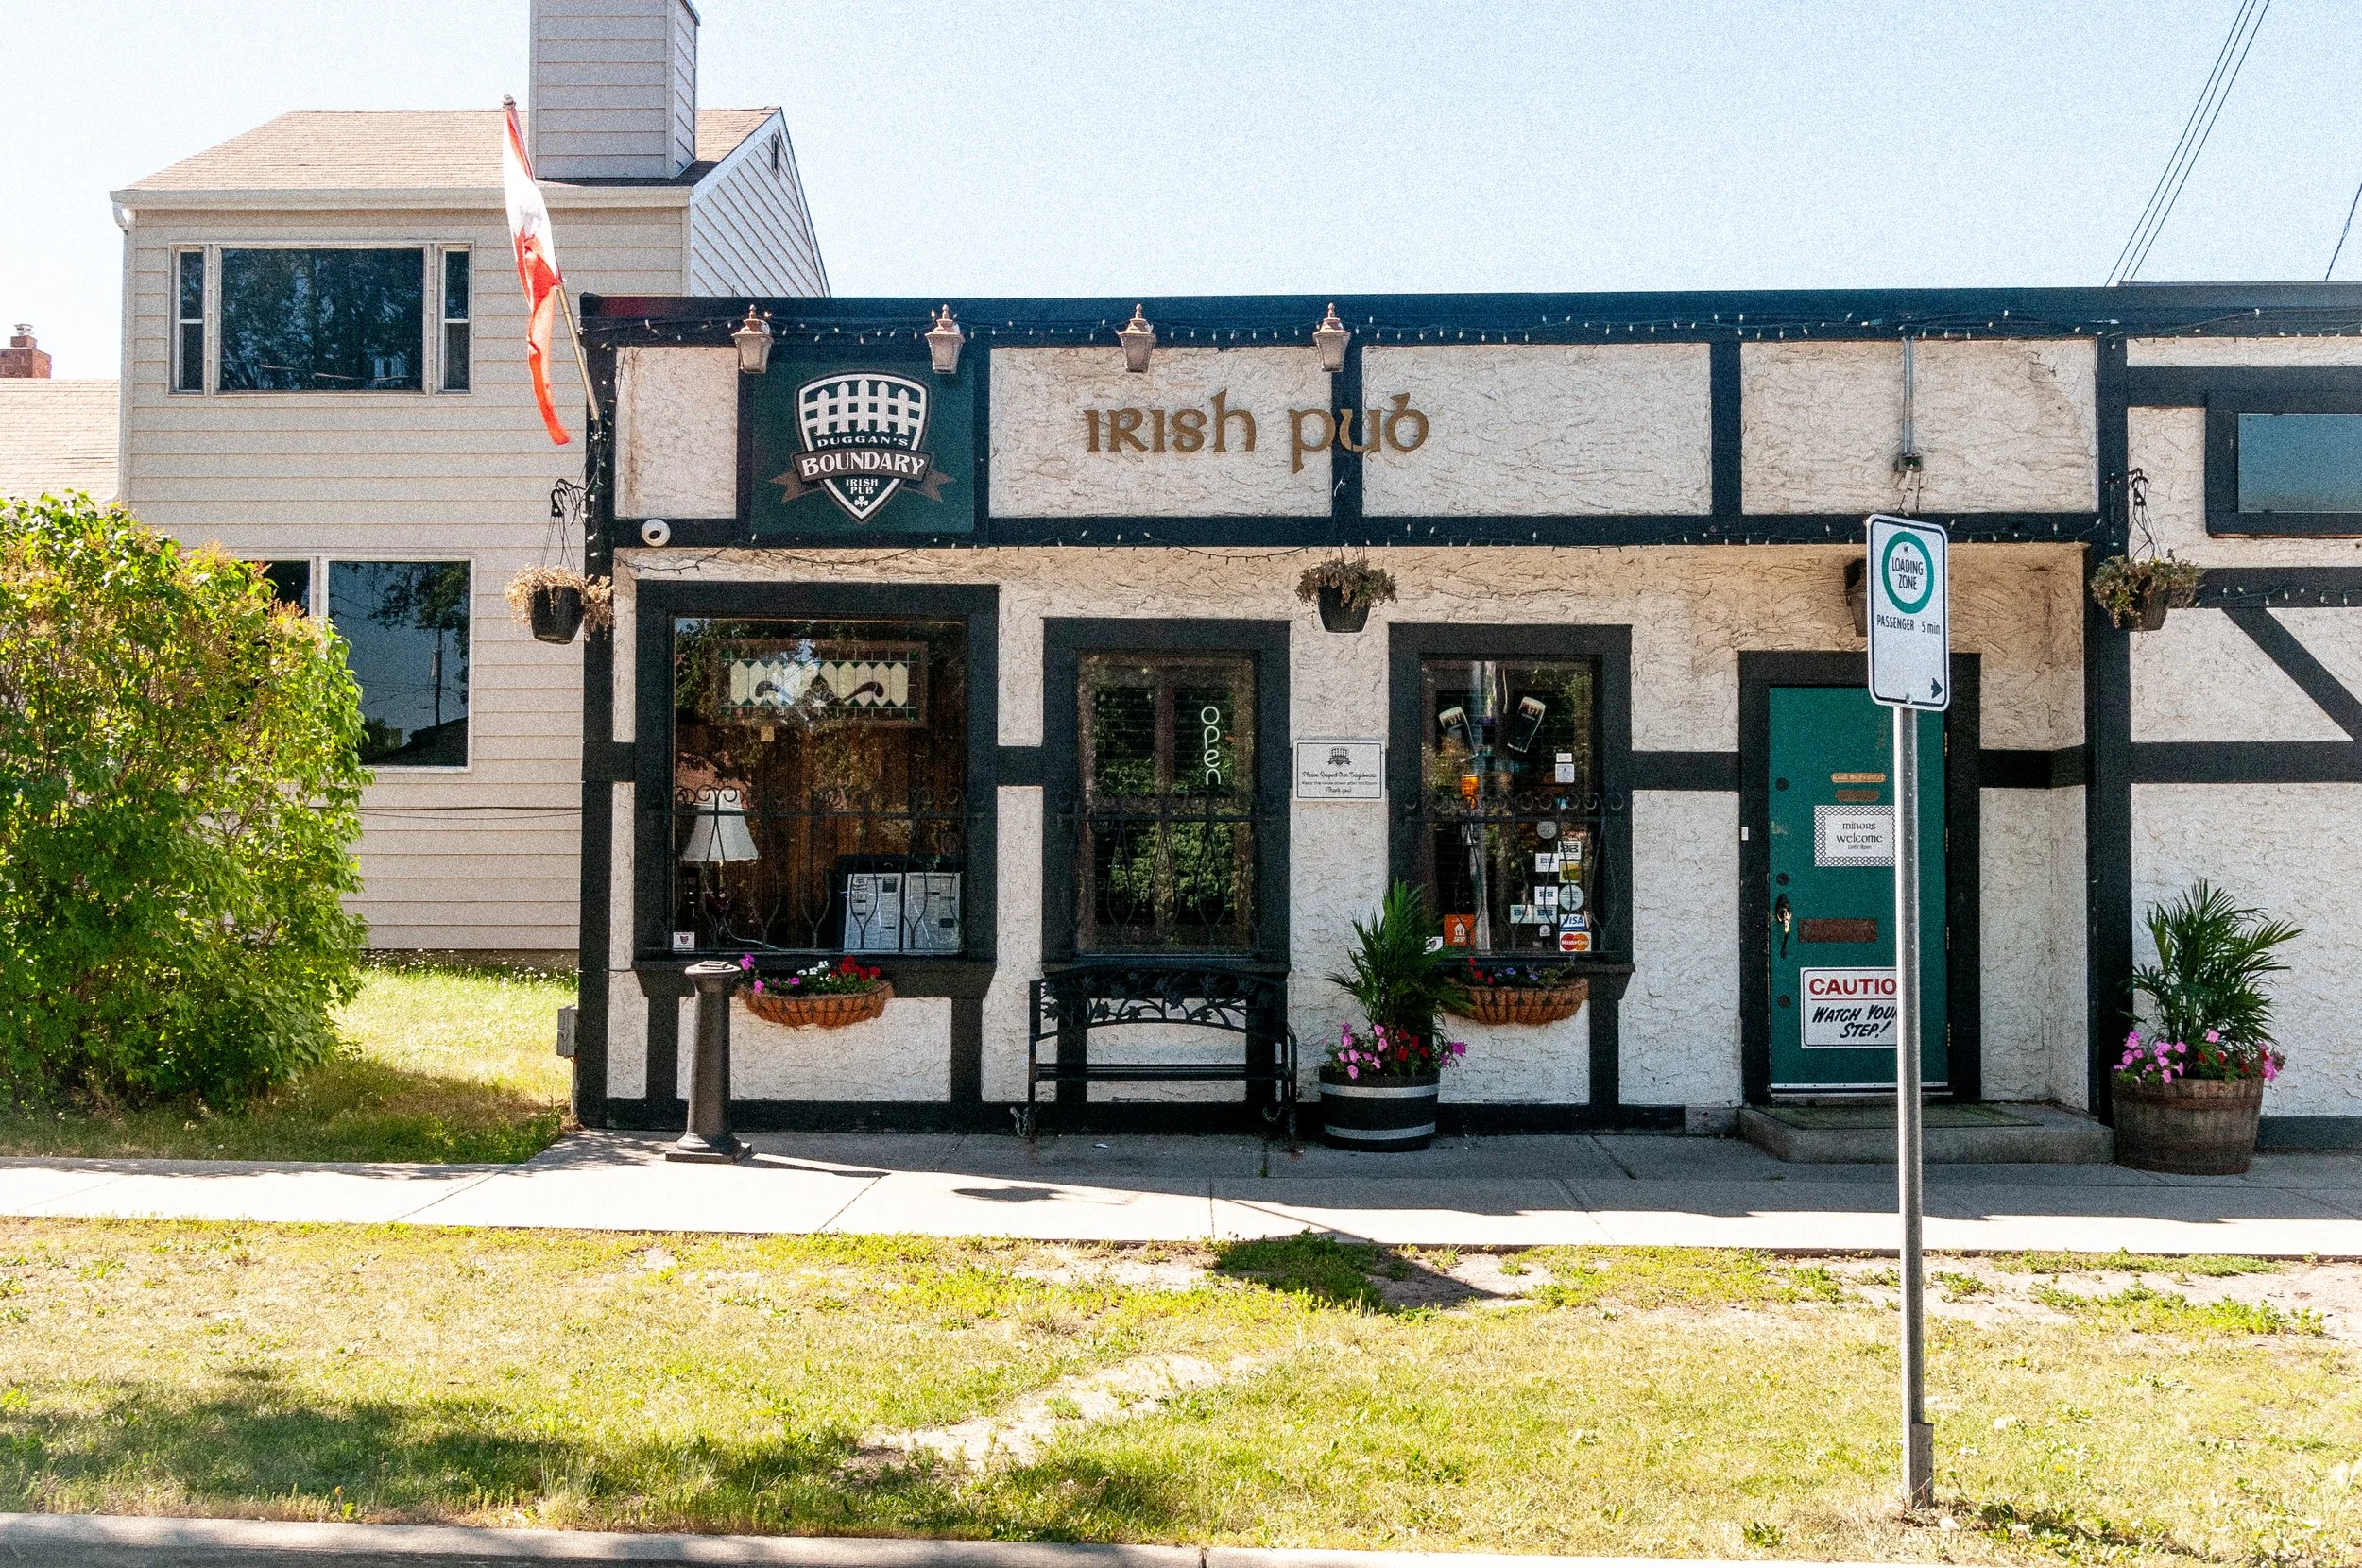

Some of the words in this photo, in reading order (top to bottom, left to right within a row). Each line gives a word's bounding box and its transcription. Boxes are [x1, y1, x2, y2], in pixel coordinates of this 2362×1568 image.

[817, 436, 909, 447] DUGGAN'S
[1288, 392, 1429, 474] pub
[801, 452, 925, 477] BOUNDARY
[846, 478, 879, 486] IRISH
[850, 486, 874, 495] PUB
[1891, 557, 1924, 576] LOADING
[1898, 574, 1917, 590] ZONE
[1876, 614, 1915, 631] PASSENGER
[1922, 621, 1926, 634] 5
[1926, 622, 1941, 635] min
[1836, 832, 1883, 844] welcome
[1809, 978, 1896, 995] CAUTIO
[1812, 1006, 1862, 1023] WATCH
[1840, 1020, 1891, 1038] STEP!
